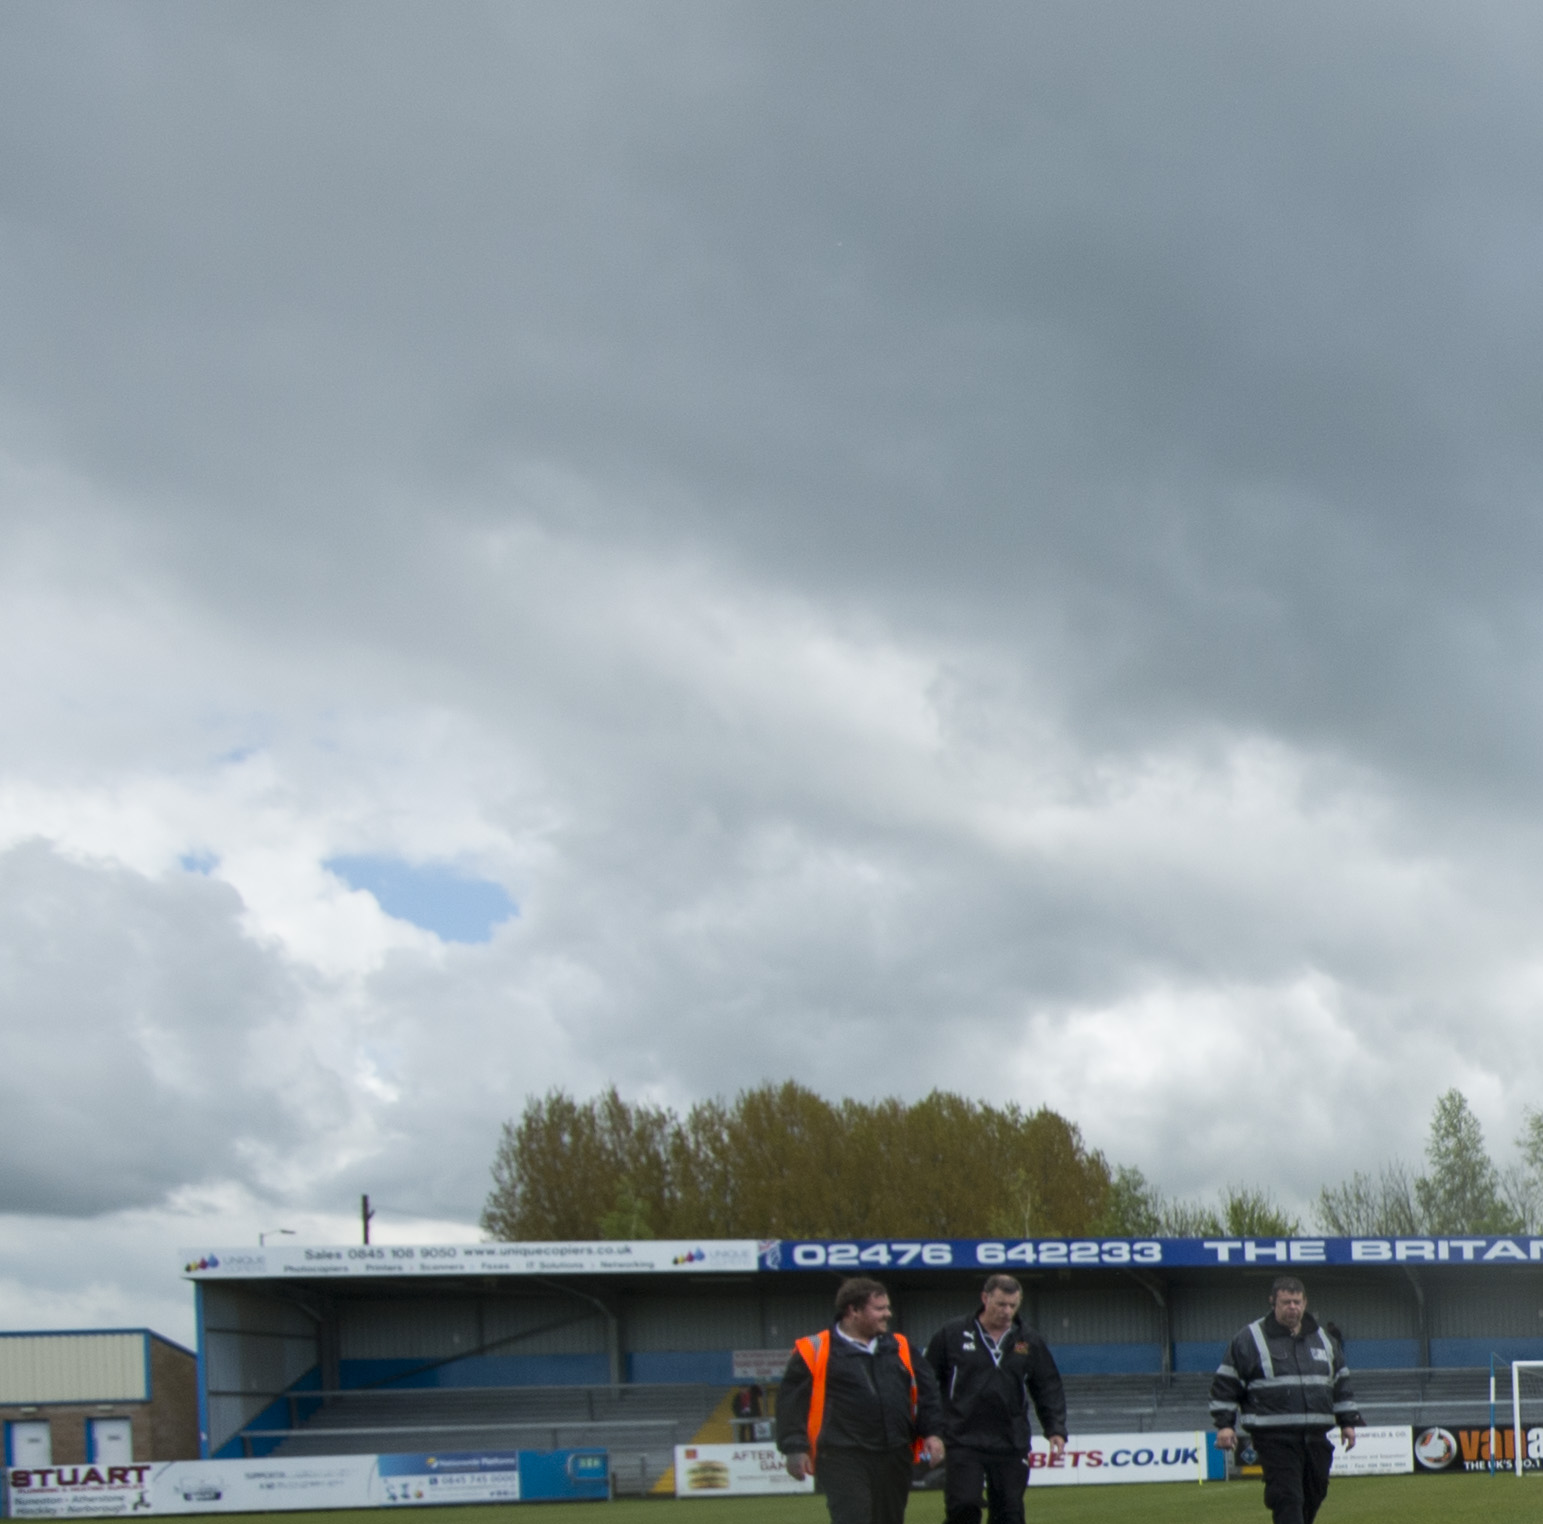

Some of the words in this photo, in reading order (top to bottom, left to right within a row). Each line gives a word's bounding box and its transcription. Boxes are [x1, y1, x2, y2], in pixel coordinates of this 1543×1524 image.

[304, 1250, 342, 1260] Sales
[348, 1249, 384, 1259] 0845
[463, 1245, 632, 1258] www.uniquecopiers.co.uk
[793, 1242, 952, 1266] 02476
[976, 1241, 1163, 1264] 642233
[1203, 1240, 1326, 1262] THE
[732, 1450, 775, 1461] AFTER
[1028, 1447, 1200, 1469] BETS.CO.UK
[1464, 1460, 1485, 1471] THE
[1515, 1457, 1541, 1468] O.1
[11, 1466, 151, 1487] STUART
